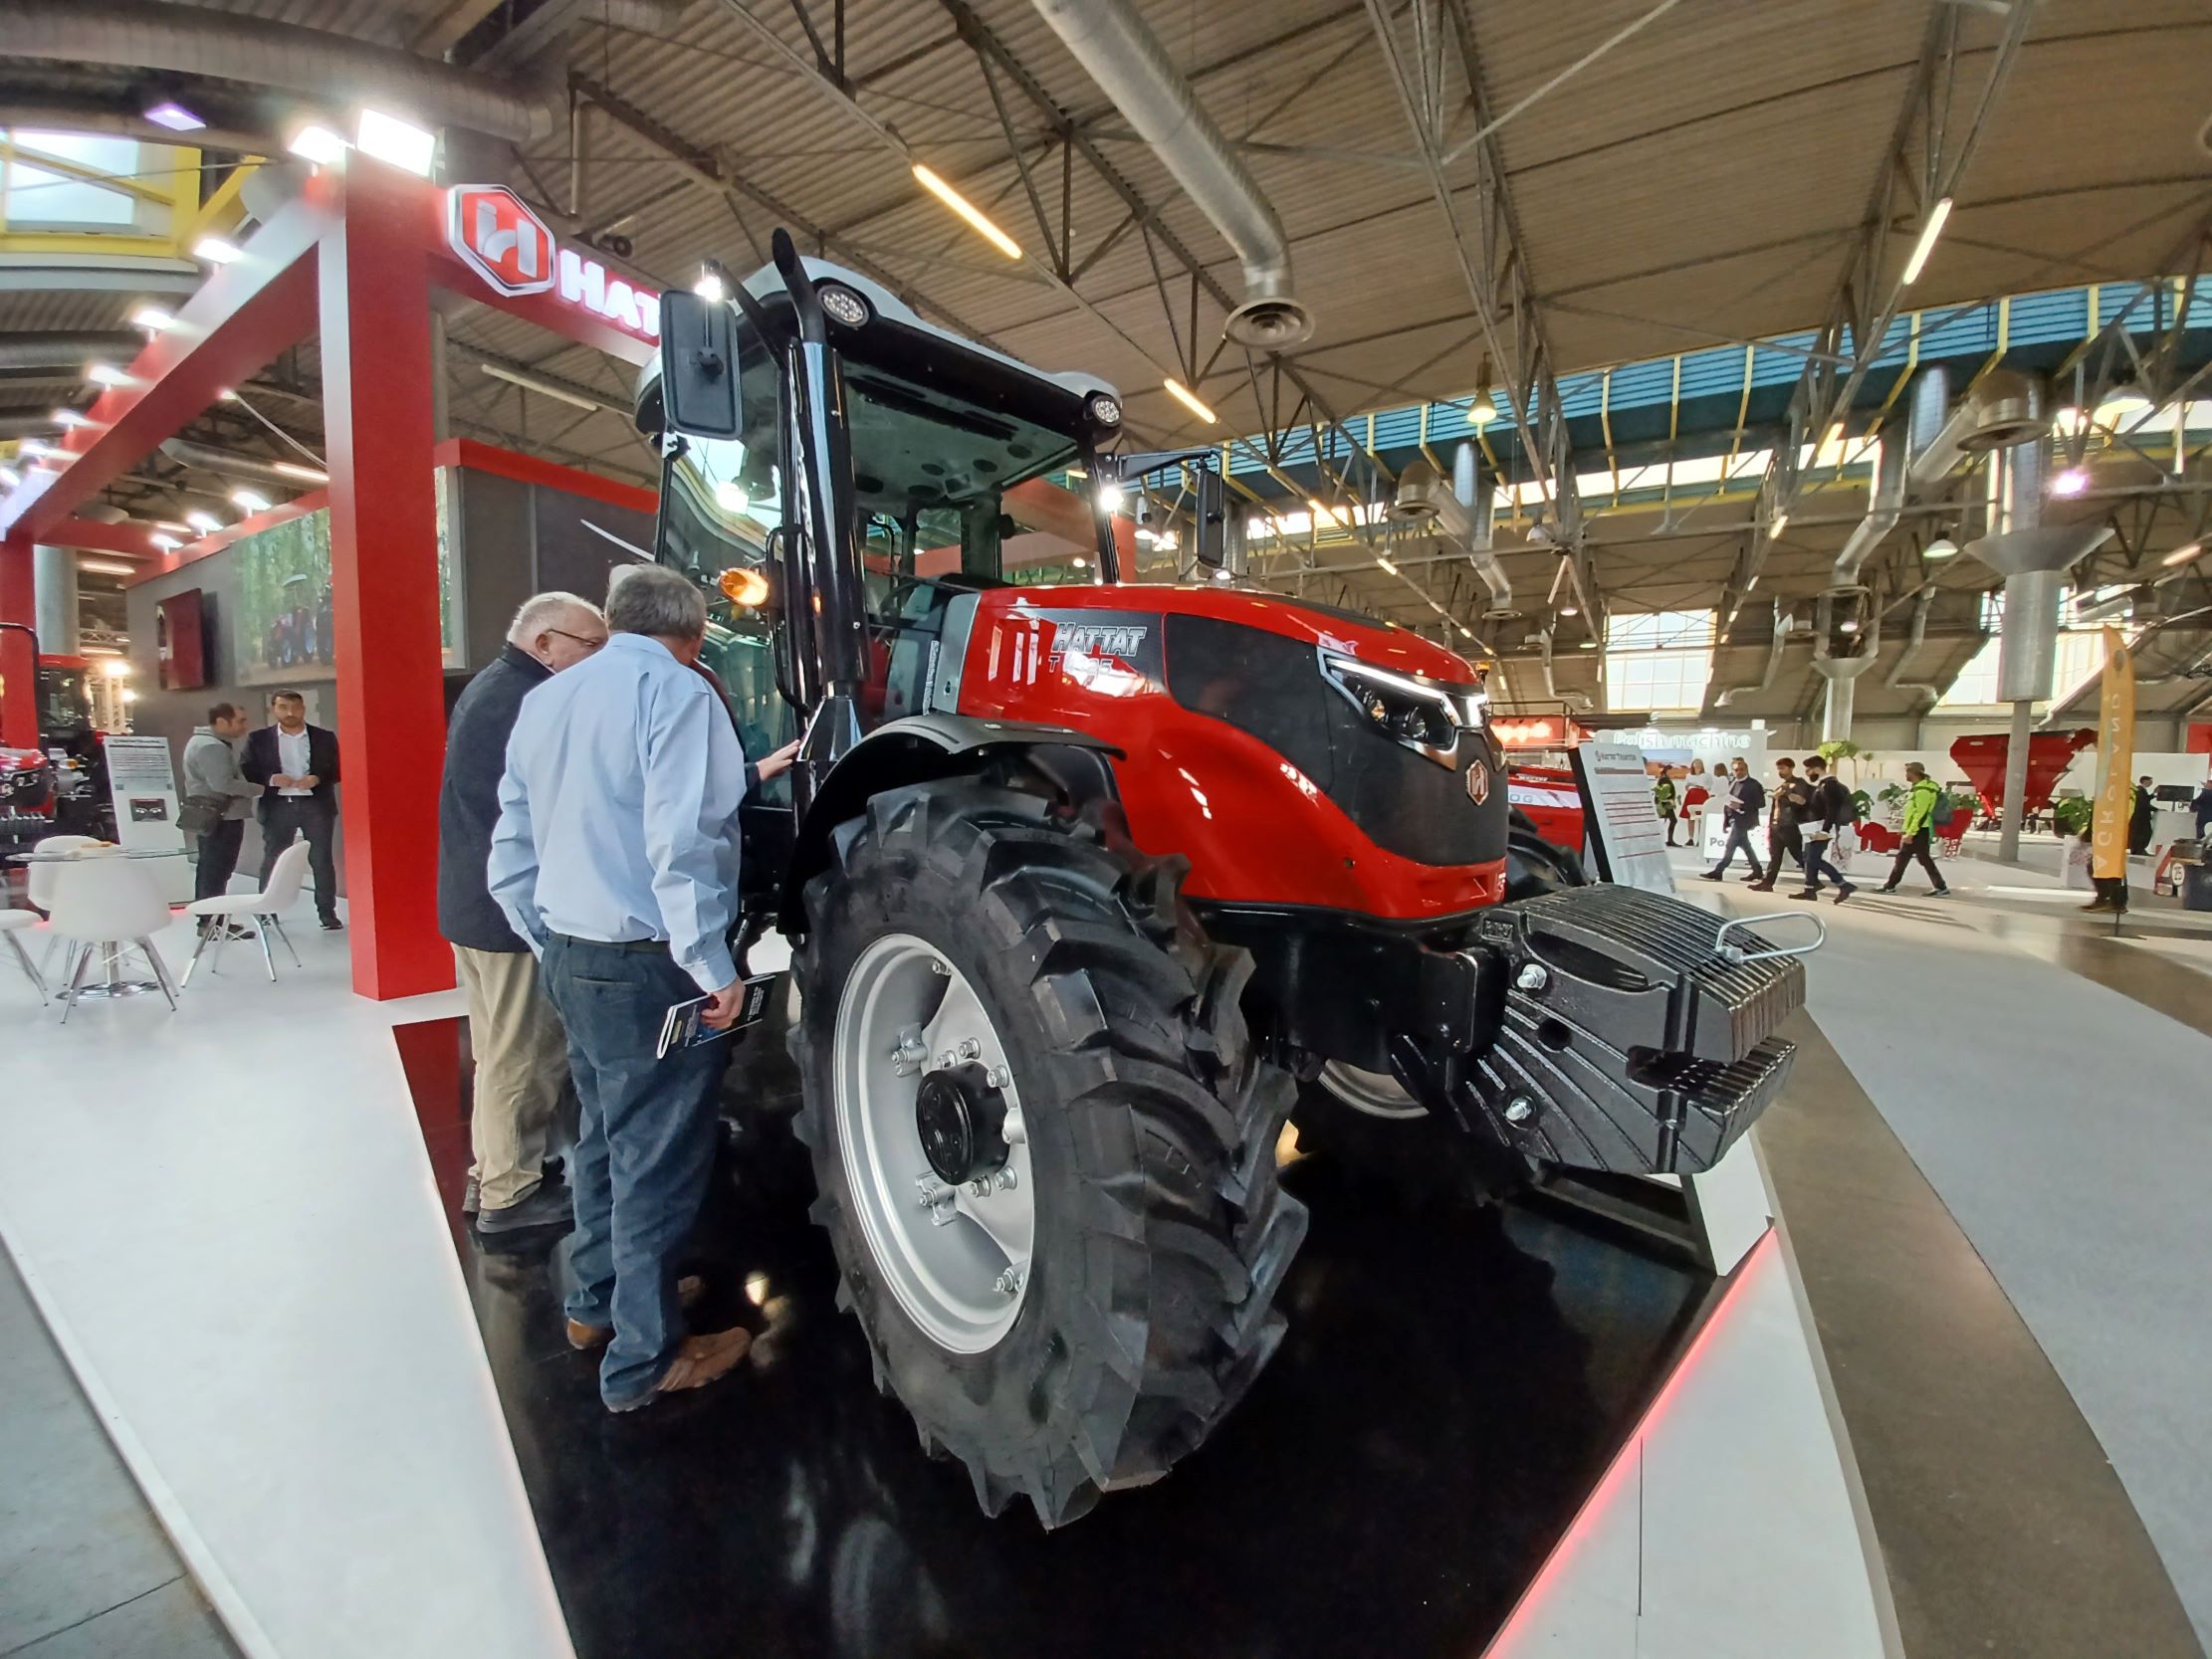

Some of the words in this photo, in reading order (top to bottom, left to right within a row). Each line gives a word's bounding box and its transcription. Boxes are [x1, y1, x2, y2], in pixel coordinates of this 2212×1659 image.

[559, 249, 660, 336] HAT
[1050, 622, 1147, 657] HATTAT
[1613, 731, 1667, 749] Polish
[1670, 732, 1752, 749] machine
